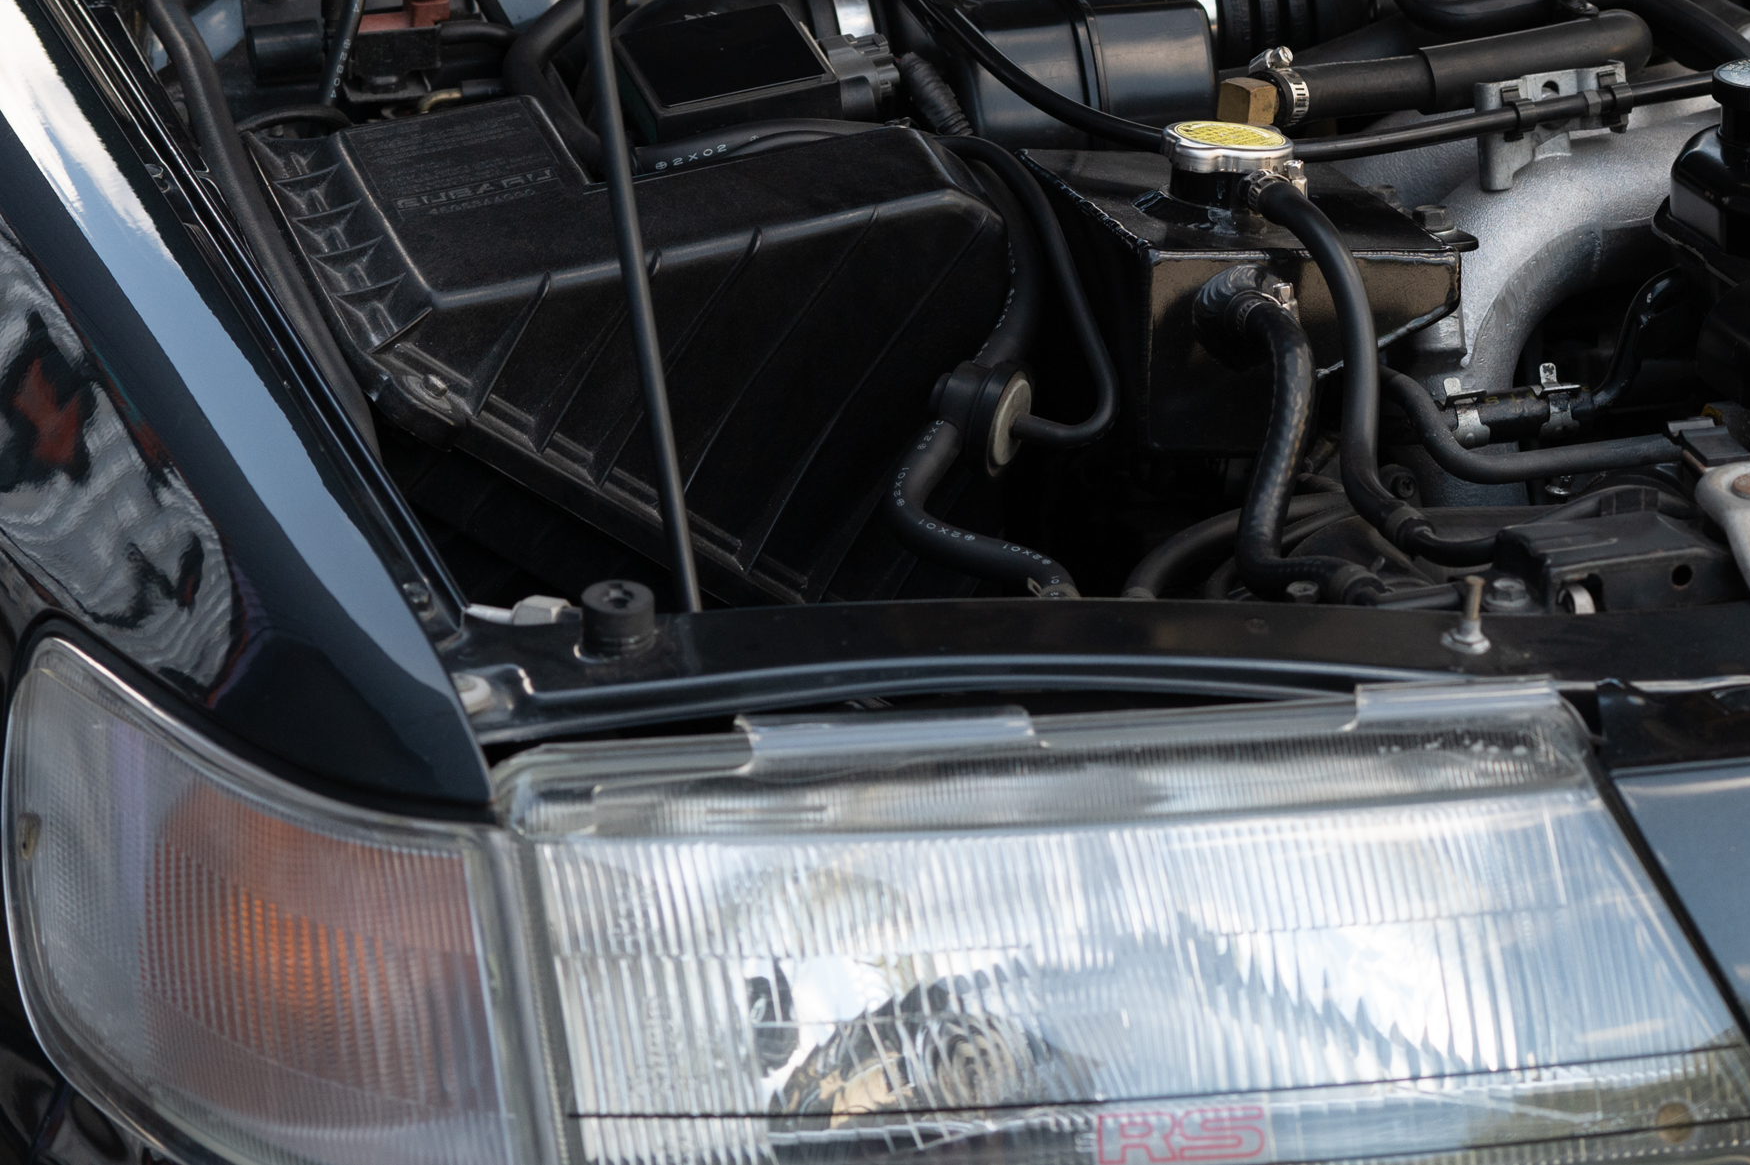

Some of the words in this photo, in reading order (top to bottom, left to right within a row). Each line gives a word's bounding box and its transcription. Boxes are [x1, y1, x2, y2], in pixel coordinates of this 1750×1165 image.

[330, 51, 348, 99] 2804
[672, 143, 728, 167] 2X02
[893, 466, 910, 498] 2X01
[917, 518, 962, 538] 2X01
[1002, 543, 1044, 561] 2X01
[1097, 1107, 1265, 1165] RS
